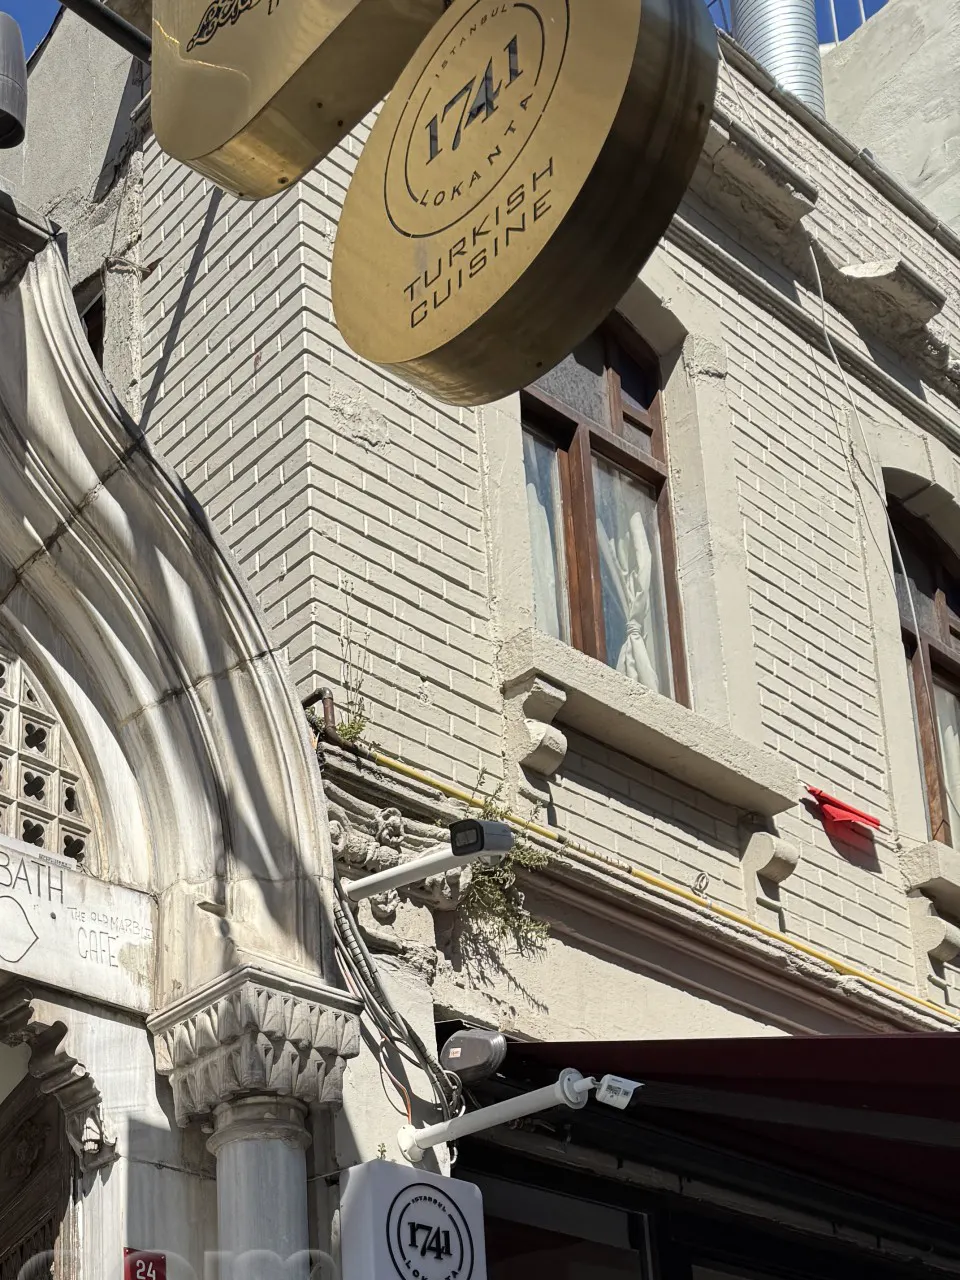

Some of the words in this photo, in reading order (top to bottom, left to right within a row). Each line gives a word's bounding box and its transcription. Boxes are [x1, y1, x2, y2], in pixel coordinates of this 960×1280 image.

[435, 4, 508, 79] ISTANBUL
[420, 93, 533, 207] LOKANTA
[424, 34, 524, 166] 1741
[403, 157, 554, 301] TURKISH
[410, 188, 553, 329] CUISINE
[67, 906, 86, 923] THE
[90, 911, 109, 924] OLD
[407, 1221, 453, 1260] 1741
